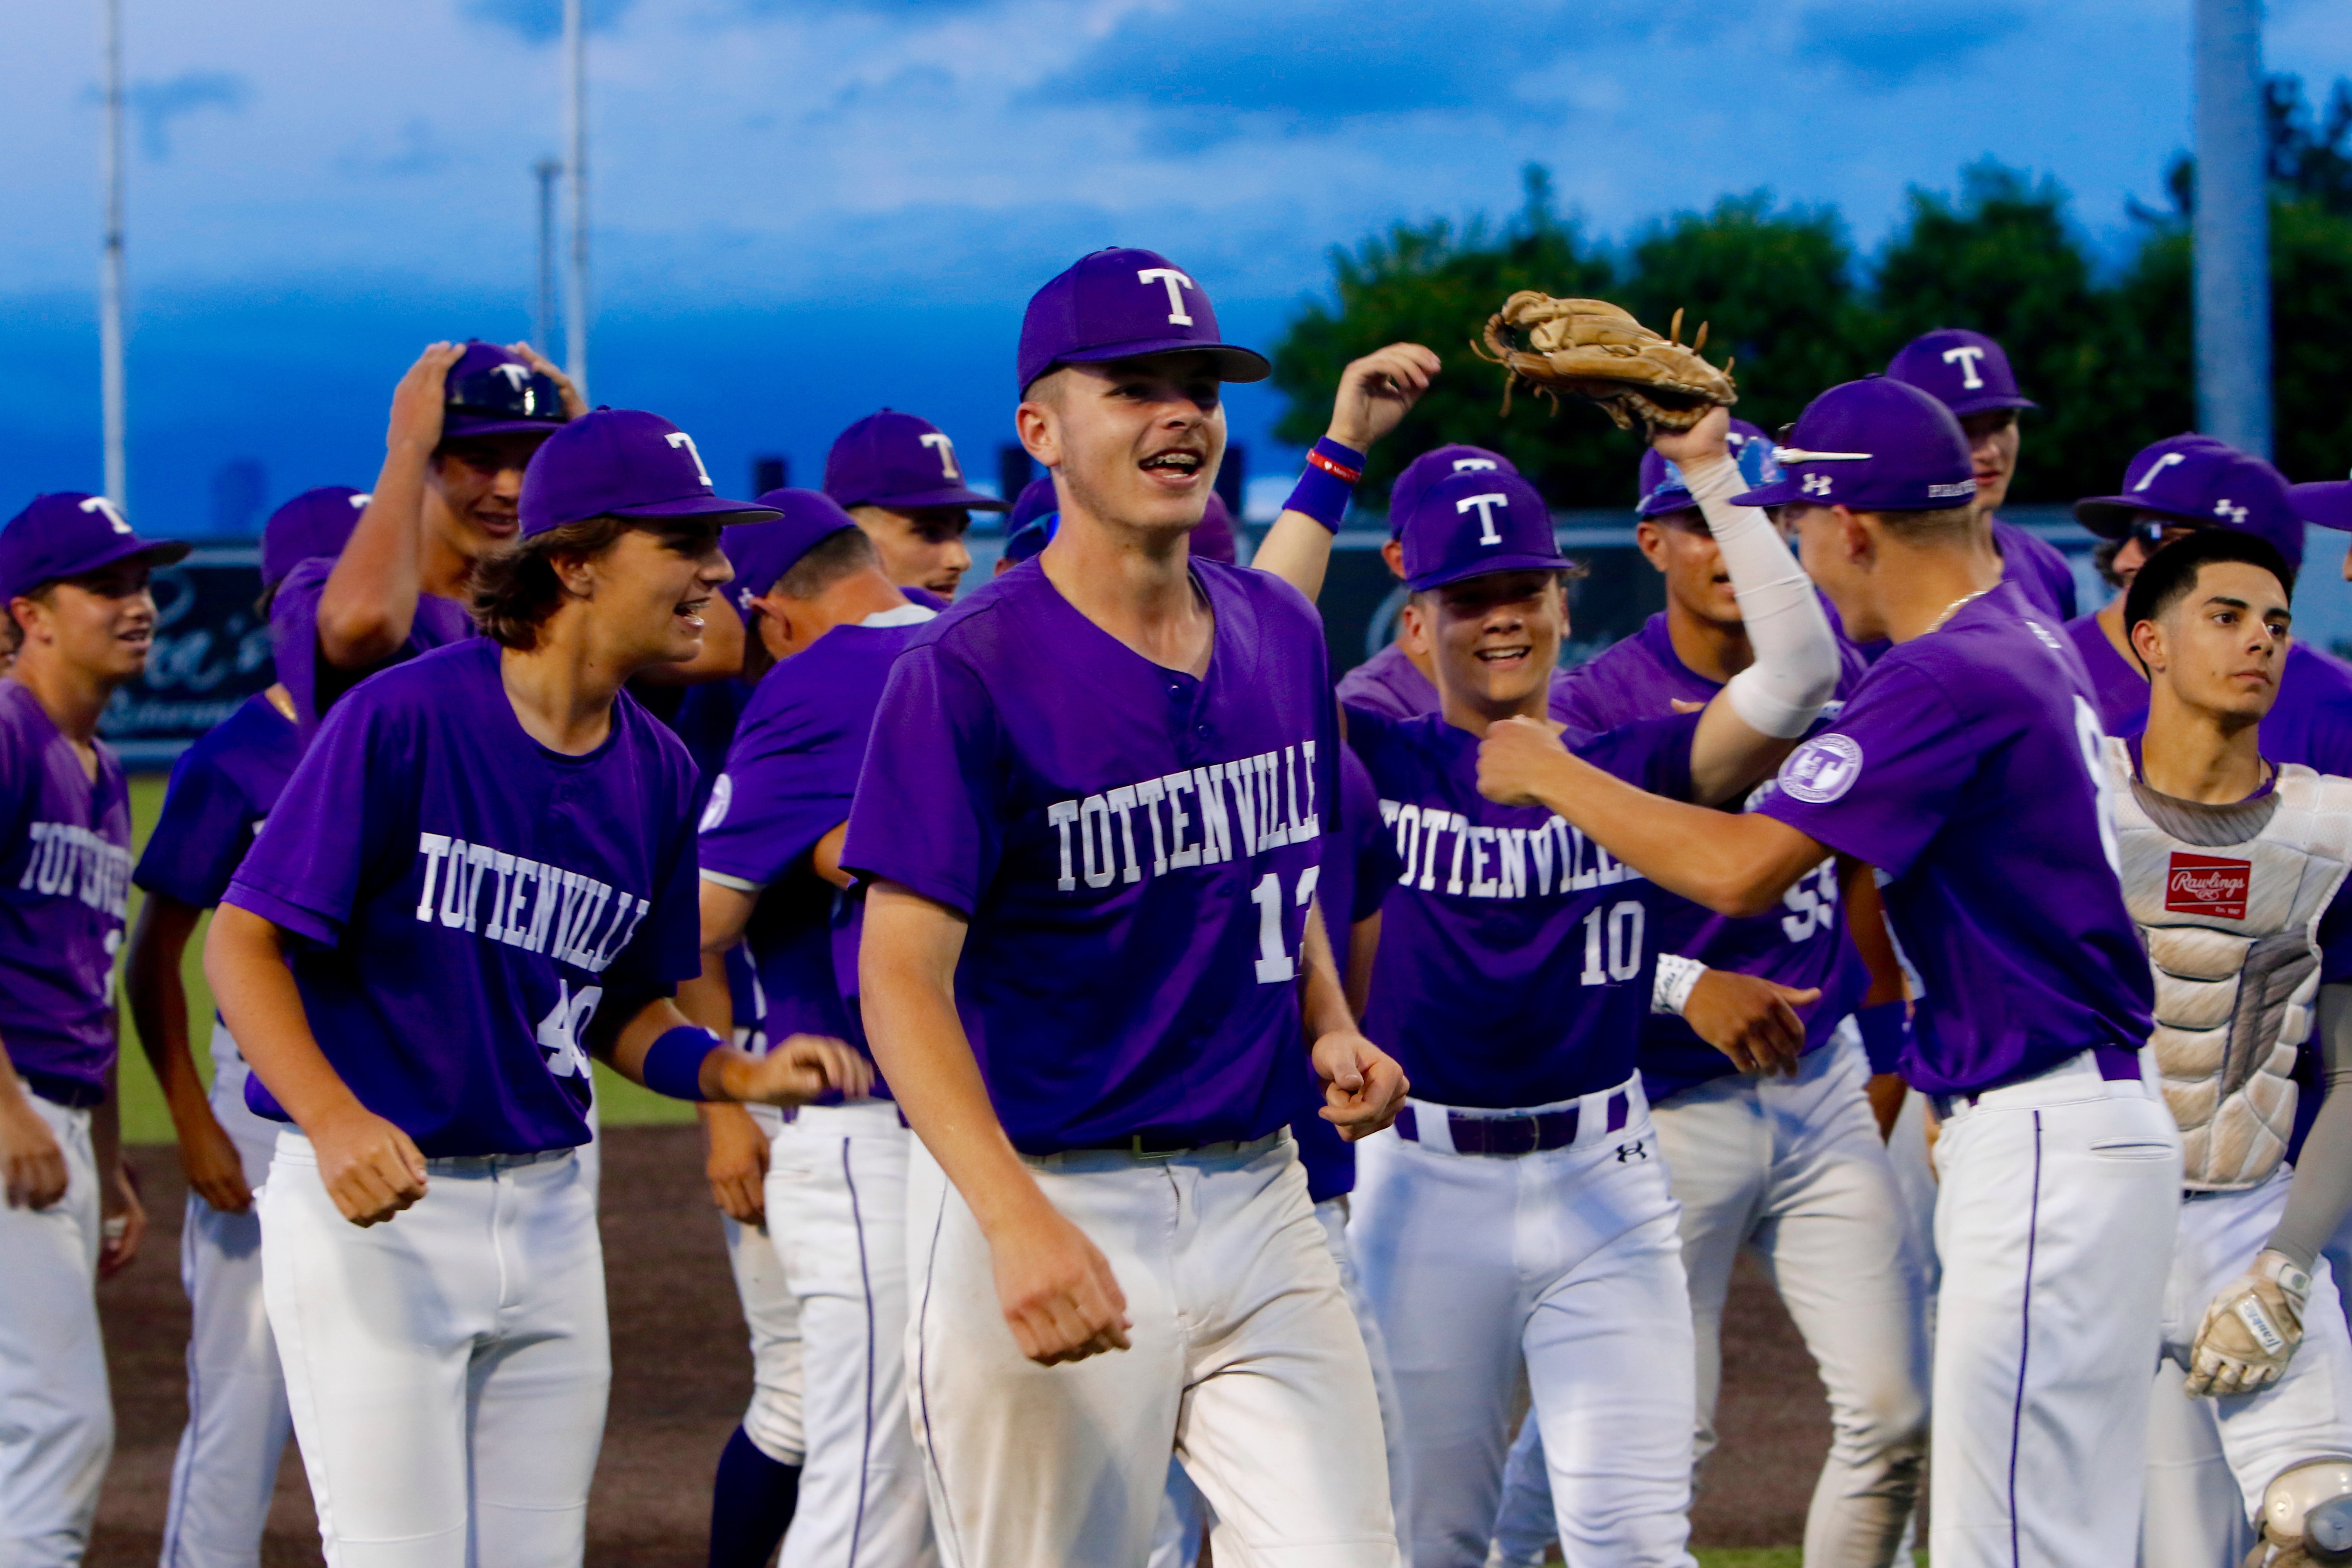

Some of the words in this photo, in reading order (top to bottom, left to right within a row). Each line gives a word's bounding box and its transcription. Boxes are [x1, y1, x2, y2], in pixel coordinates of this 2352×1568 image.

[1137, 268, 1194, 327] T
[1942, 346, 1985, 389] T
[664, 432, 713, 487] T
[919, 433, 959, 478] T
[79, 496, 133, 534] T
[1455, 493, 1508, 546] T
[1378, 798, 1645, 899] OTTENVILL
[2171, 871, 2245, 898] Rawlings
[1581, 900, 1645, 986] 10
